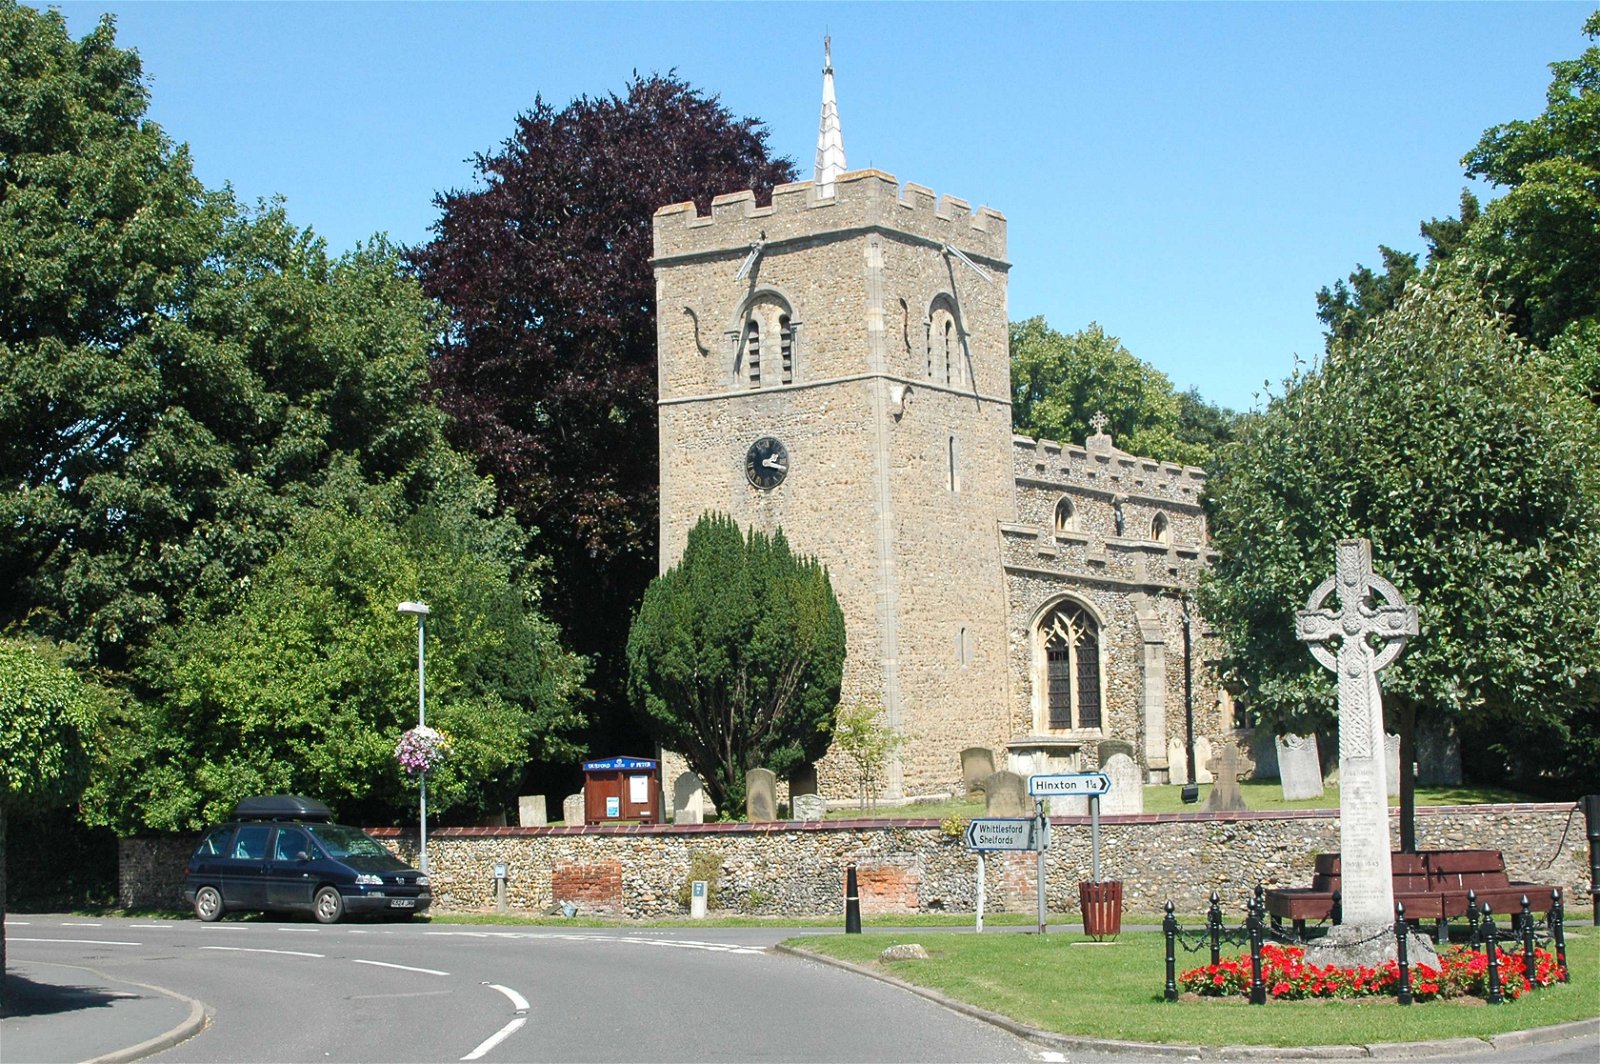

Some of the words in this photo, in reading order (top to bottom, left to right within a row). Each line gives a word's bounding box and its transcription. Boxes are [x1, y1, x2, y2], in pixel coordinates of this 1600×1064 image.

[1036, 780, 1077, 790] Hinxton
[979, 824, 1023, 833] Whittlesford
[979, 835, 1013, 844] Shelfords
